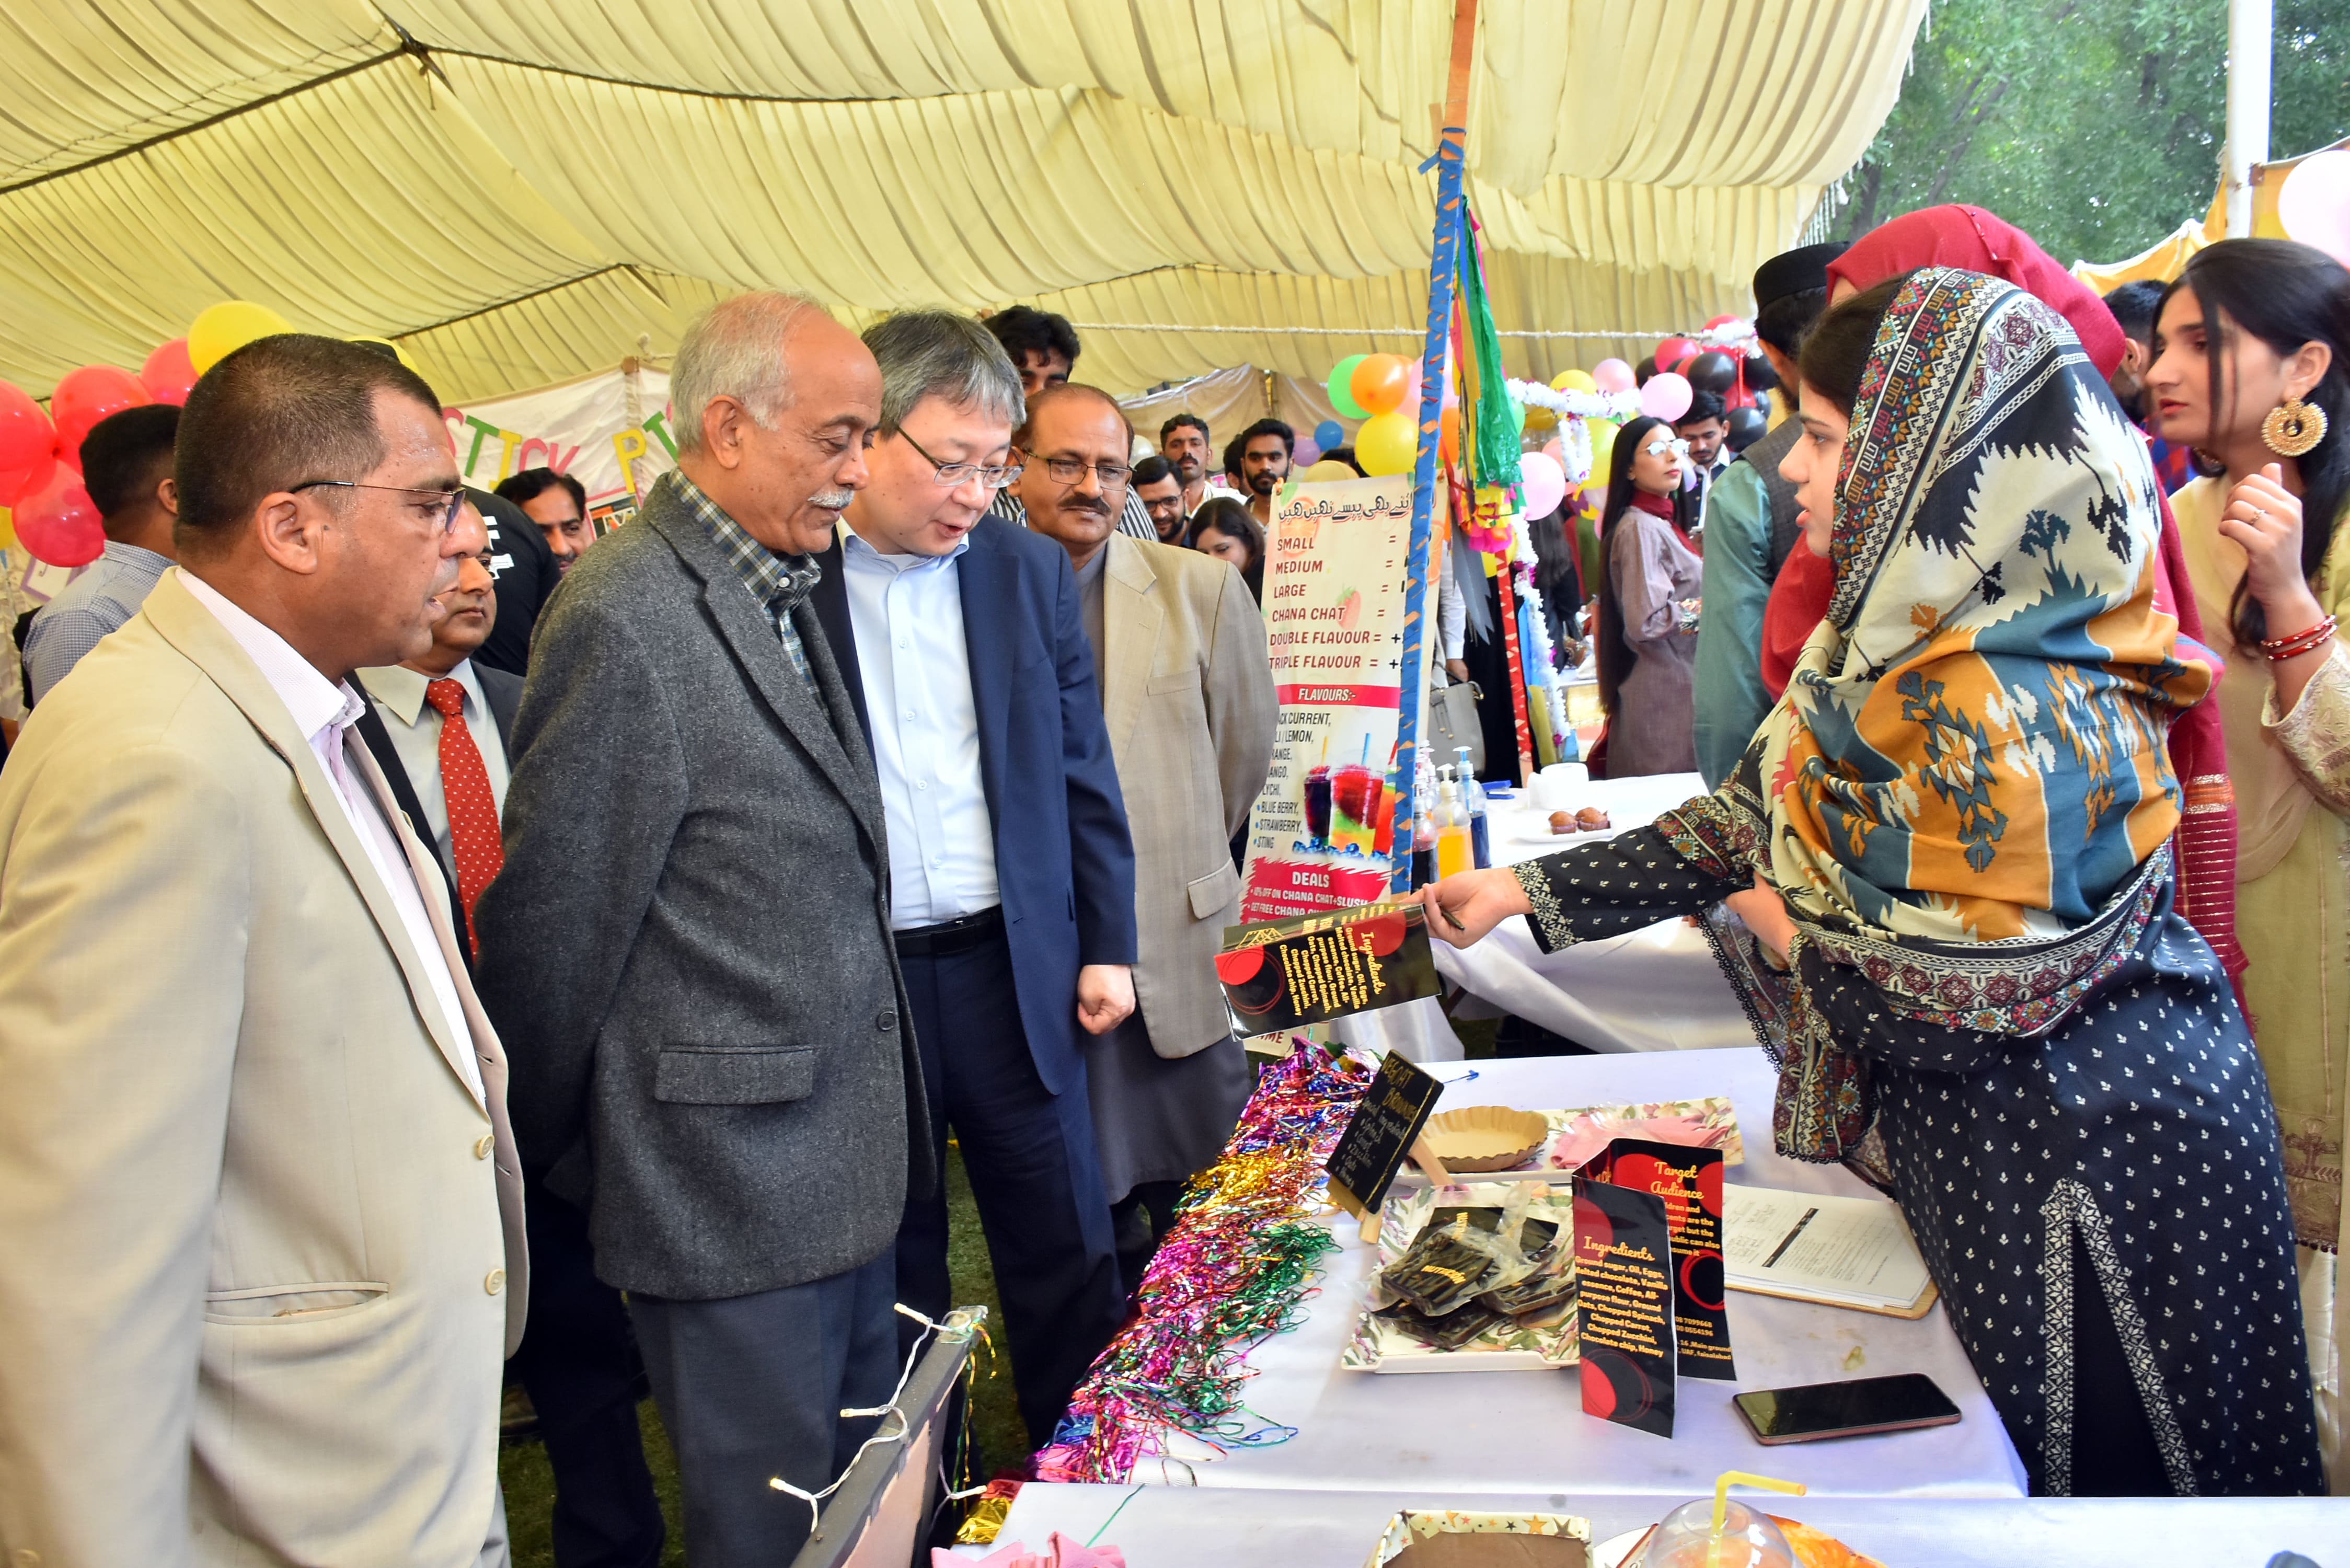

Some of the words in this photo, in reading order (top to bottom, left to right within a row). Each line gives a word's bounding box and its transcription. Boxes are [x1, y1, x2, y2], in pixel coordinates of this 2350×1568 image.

[1277, 537, 1315, 551] SMALL
[1276, 560, 1322, 574] MEDIUM
[1274, 584, 1306, 598] LARGE
[1272, 608, 1306, 622] CHANA
[1311, 607, 1345, 620] CHAT
[1270, 631, 1308, 645] DOUBLE
[1312, 631, 1370, 644] FLAVOUR
[1269, 655, 1299, 669] TRIPLE
[1303, 656, 1361, 668] FLAVOUR
[1288, 712, 1331, 727] CURRENT,
[1268, 766, 1288, 779] ANGO,
[1261, 801, 1276, 813] BLUE
[1277, 802, 1298, 816] BERRY,
[1260, 819, 1303, 835] STRAWBERRY,
[1292, 872, 1330, 888] DEALS
[1283, 890, 1313, 902] CHANA
[1275, 905, 1305, 916] CHANA
[1345, 927, 1358, 952] Ground
[1280, 944, 1293, 977] Chocolate
[1328, 937, 1339, 966] essence,
[1335, 966, 1345, 991] Coffee,
[1335, 927, 1347, 951] Melted
[1341, 951, 1354, 986] chocolate,
[1350, 986, 1361, 1009] Vanilla
[1351, 952, 1361, 973] sugar,
[1359, 932, 1386, 995] Ingredients
[1291, 949, 1304, 978] Chopped
[1298, 978, 1311, 1009] Zucchini,
[1301, 950, 1315, 979] Chopped
[1308, 979, 1319, 1004] Carrot,
[1307, 936, 1316, 954] Oats,
[1312, 954, 1326, 984] Chopped
[1319, 984, 1332, 1013] Spinach,
[1316, 937, 1329, 964] purpose
[1324, 964, 1333, 983] flour,
[1329, 983, 1342, 1008] Ground
[1356, 974, 1365, 985] Oil,
[1288, 978, 1297, 995] chip,
[1359, 985, 1368, 1005] Eggs,
[1292, 994, 1302, 1016] Honey
[1654, 1162, 1698, 1183] Target
[1651, 1181, 1704, 1200] Audience
[1665, 1202, 1685, 1211] ldren
[1686, 1227, 1700, 1235] but
[1700, 1229, 1714, 1237] the
[1583, 1236, 1655, 1261] Ingredients
[1704, 1240, 1721, 1249] also
[1575, 1255, 1603, 1267] Ground
[1604, 1261, 1628, 1272] sugar,
[1629, 1265, 1642, 1275] Oil,
[1642, 1267, 1665, 1279] Eggs,
[1575, 1266, 1599, 1278] Melted
[1600, 1272, 1640, 1286] chocolate,
[1641, 1278, 1668, 1290] Vanilla
[1582, 1281, 1615, 1293] essence,
[1615, 1285, 1644, 1298] Coffee,
[1580, 1290, 1610, 1302] purpose
[1611, 1296, 1632, 1307] flour,
[1632, 1300, 1662, 1312] Ground
[1577, 1299, 1597, 1311] Oats,
[1597, 1304, 1631, 1317] Chopped
[1632, 1311, 1665, 1325] Spinach,
[1591, 1313, 1624, 1326] Chopped
[1625, 1320, 1652, 1333] Carrot,
[1587, 1323, 1621, 1336] Chopped
[1621, 1331, 1657, 1345] Zucchini,
[1581, 1332, 1618, 1347] Chocolate
[1619, 1341, 1638, 1352] chip,
[1638, 1344, 1664, 1358] Honey
